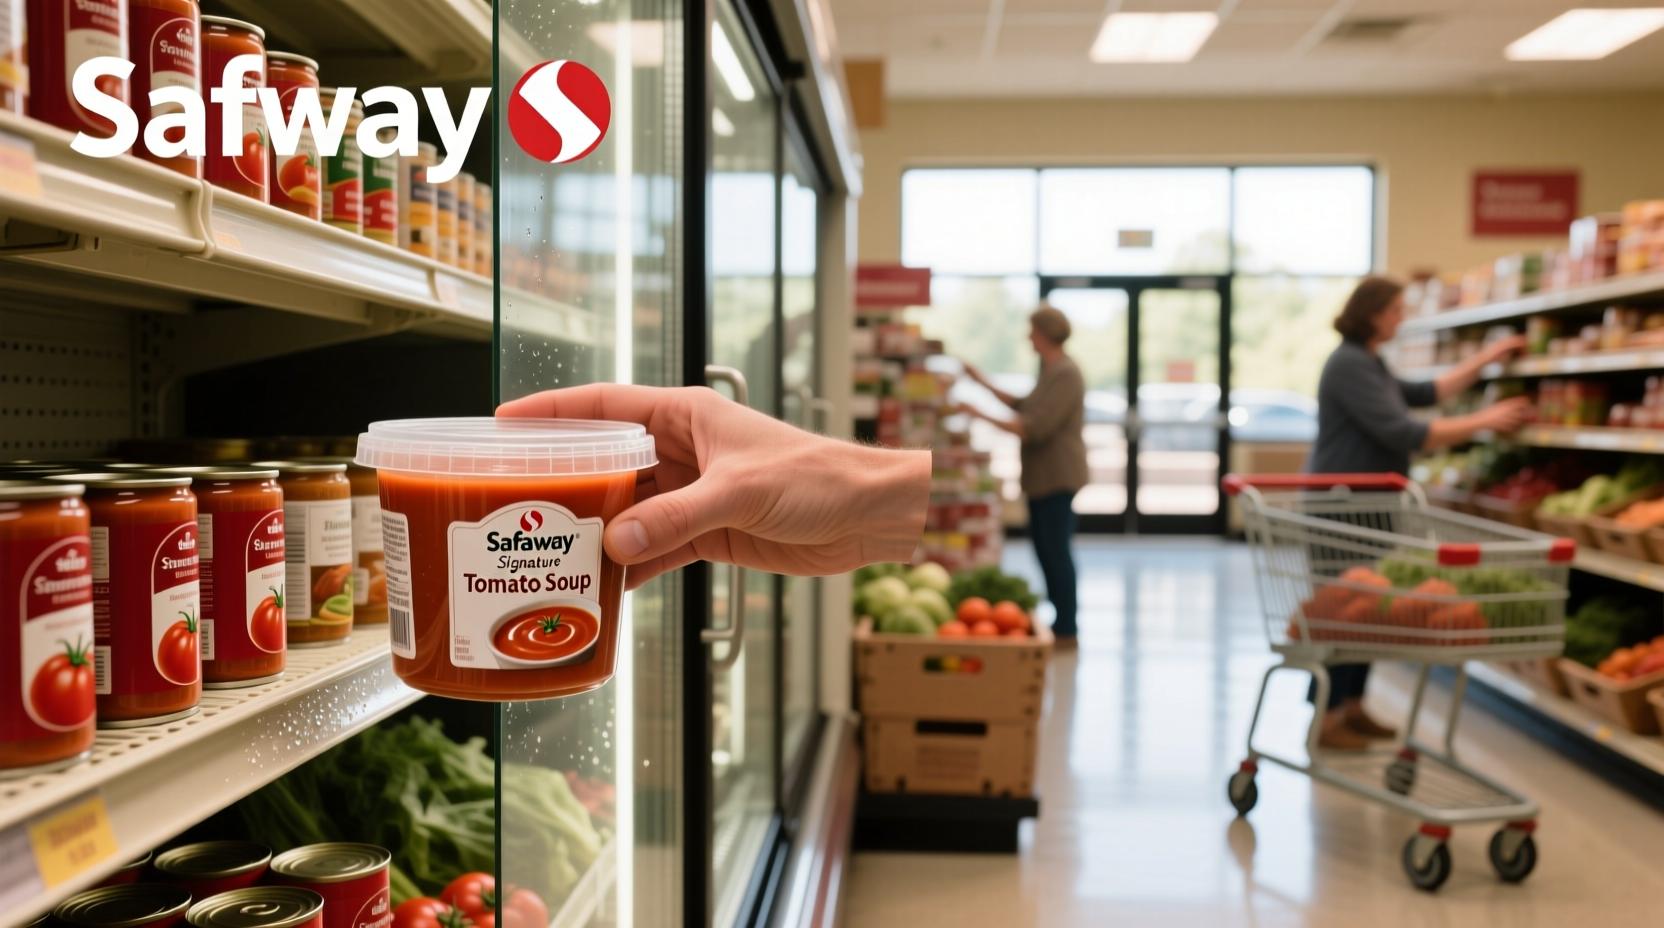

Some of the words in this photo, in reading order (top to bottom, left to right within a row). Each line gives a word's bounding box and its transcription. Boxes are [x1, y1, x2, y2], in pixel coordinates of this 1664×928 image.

[486, 530, 575, 555] Safaway
[497, 555, 561, 574] Signature
[463, 572, 541, 593] Tomato
[545, 572, 592, 595] Soup
